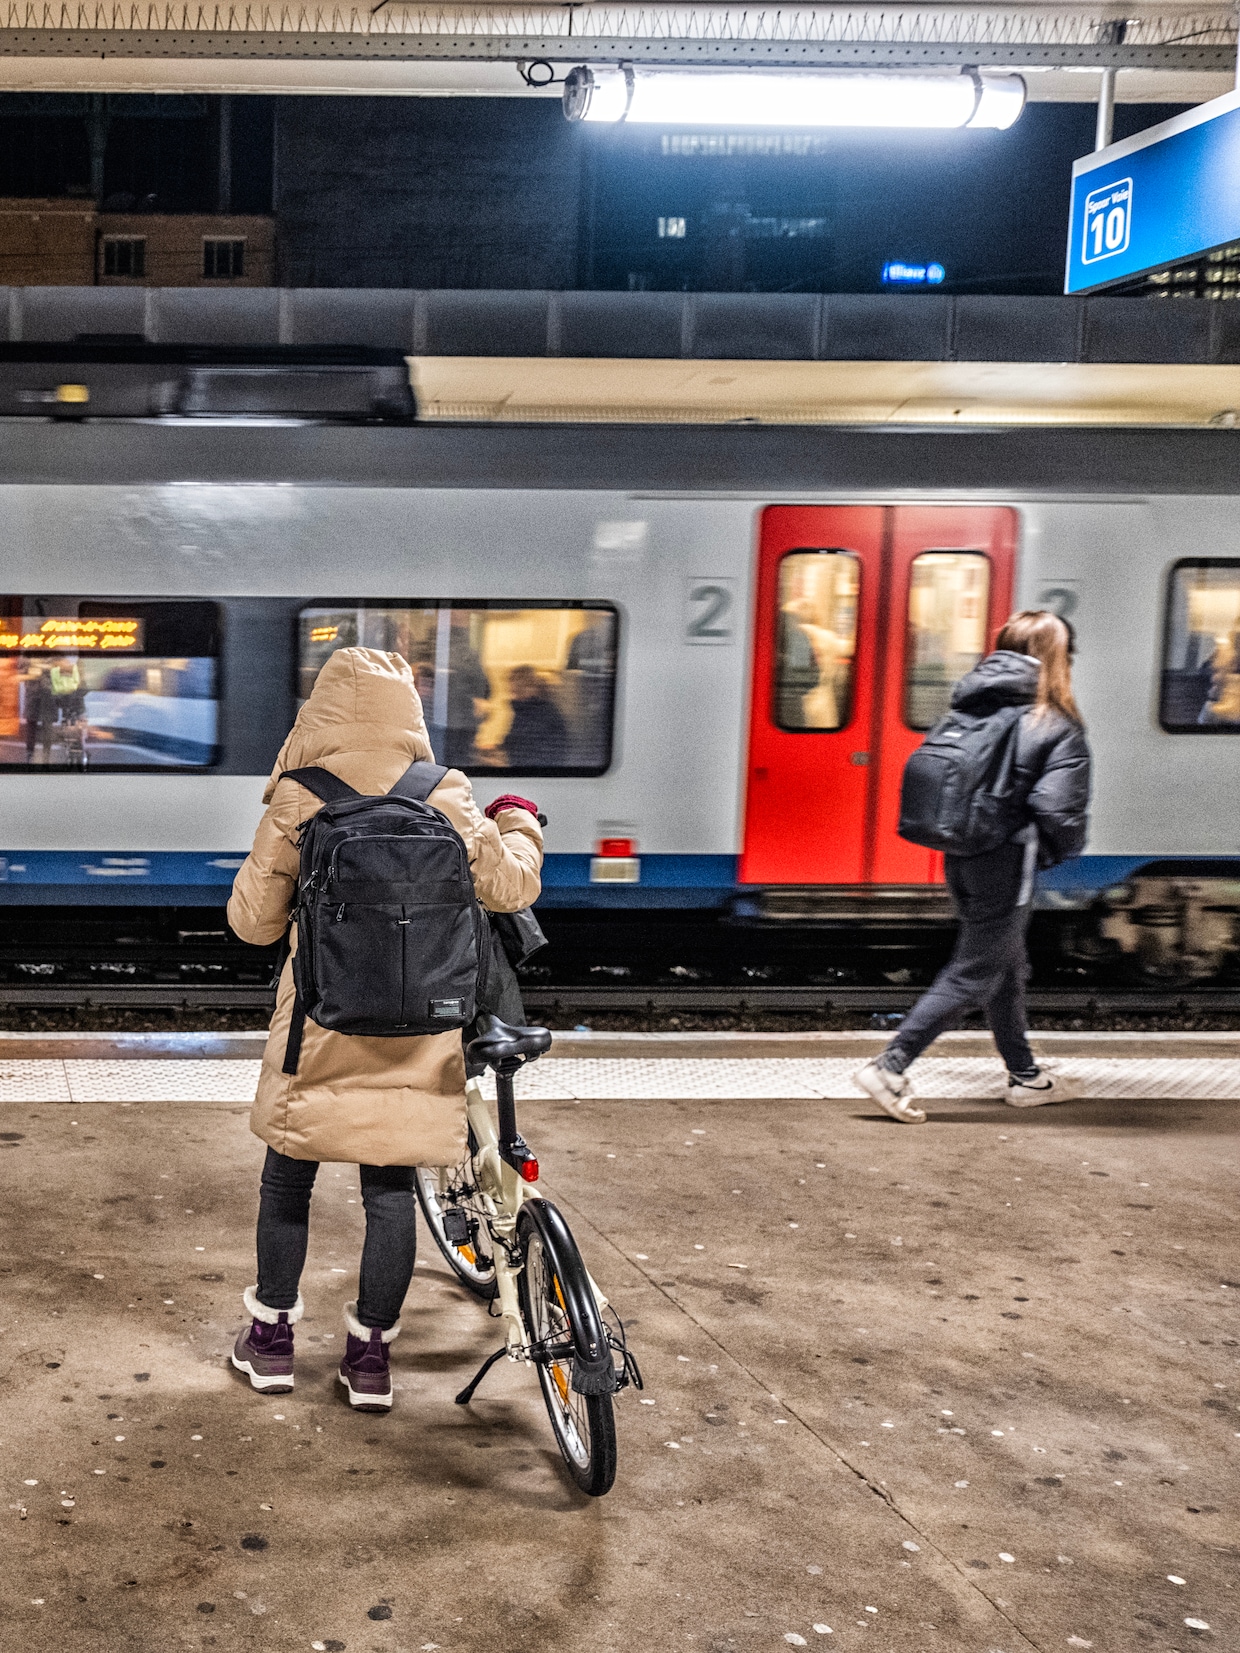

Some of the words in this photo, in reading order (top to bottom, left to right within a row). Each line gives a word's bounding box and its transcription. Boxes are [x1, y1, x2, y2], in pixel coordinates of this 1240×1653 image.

[1111, 189, 1129, 204] Voie
[1091, 207, 1125, 255] 10
[687, 585, 731, 637] 2
